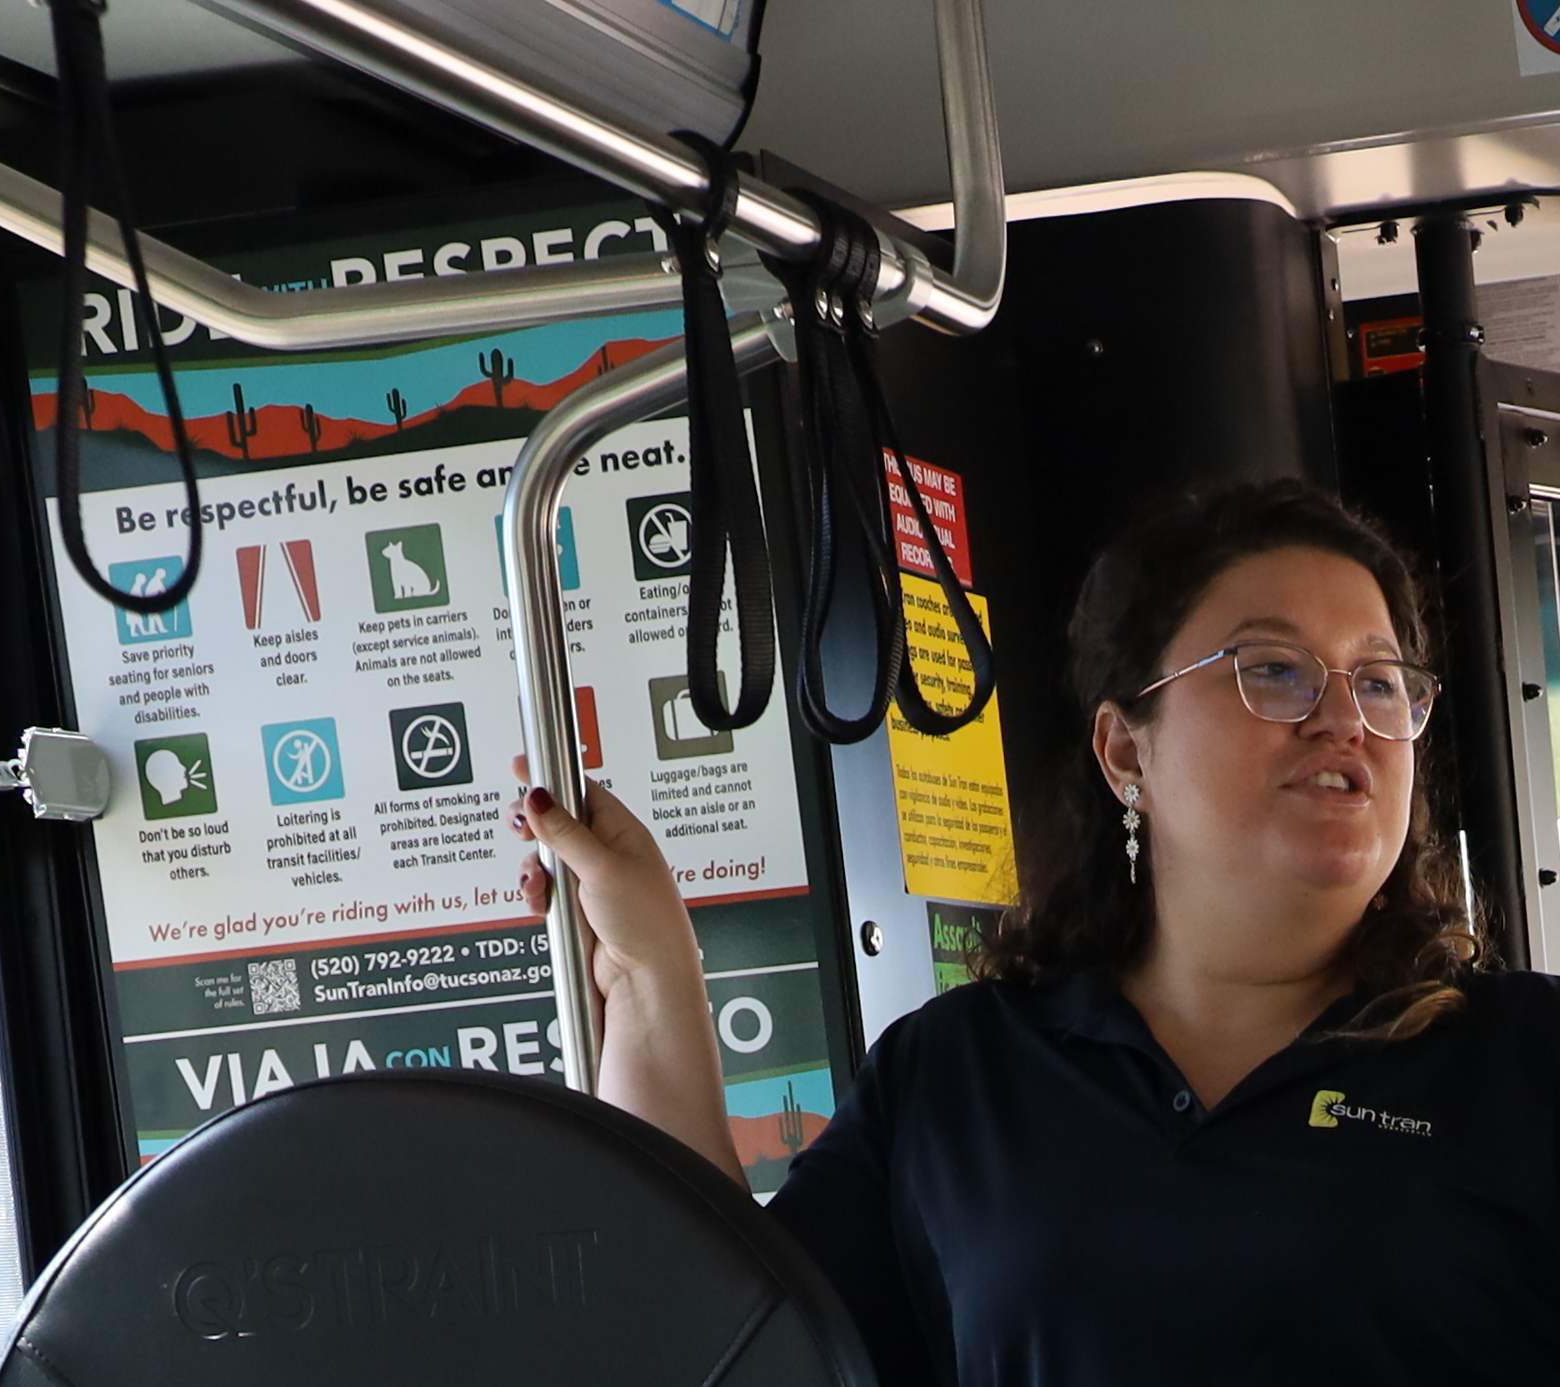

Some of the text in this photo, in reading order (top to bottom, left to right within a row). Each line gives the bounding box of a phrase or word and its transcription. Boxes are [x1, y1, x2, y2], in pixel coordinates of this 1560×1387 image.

[116, 440, 684, 533] Be respectful, be safe neat.
[923, 467, 957, 497] MAY BE
[933, 498, 956, 523] WITH
[359, 611, 467, 633] Keep pets in carriers
[253, 628, 318, 647] Keep aisles
[352, 627, 478, 654] (except service animals).
[122, 644, 193, 663] Save priority
[260, 651, 317, 667] and doors
[355, 645, 480, 671] Animals are not allowed
[109, 663, 213, 685] seating for seniors
[276, 673, 306, 686] clear.
[387, 670, 453, 687] on the seats.
[119, 683, 209, 705] and people with
[134, 707, 199, 723] disabilities.
[650, 762, 747, 783] Luggage/bags are
[651, 779, 751, 801] limited and cannot
[652, 800, 755, 820] block an aisle or an
[139, 820, 228, 843] Don't be so loud
[665, 818, 746, 837] additional seat.
[142, 841, 230, 862] that you disturb
[170, 866, 208, 879] others.
[149, 856, 765, 941] We're glad you're riding with us, let us doing!
[311, 938, 524, 979] (520) 792-9222 TDD:
[314, 964, 553, 1002] SunTranInfo@tucsonaz.go
[385, 1046, 451, 1069] CON
[1330, 1103, 1375, 1122] sun
[1379, 1111, 1431, 1132] tran
